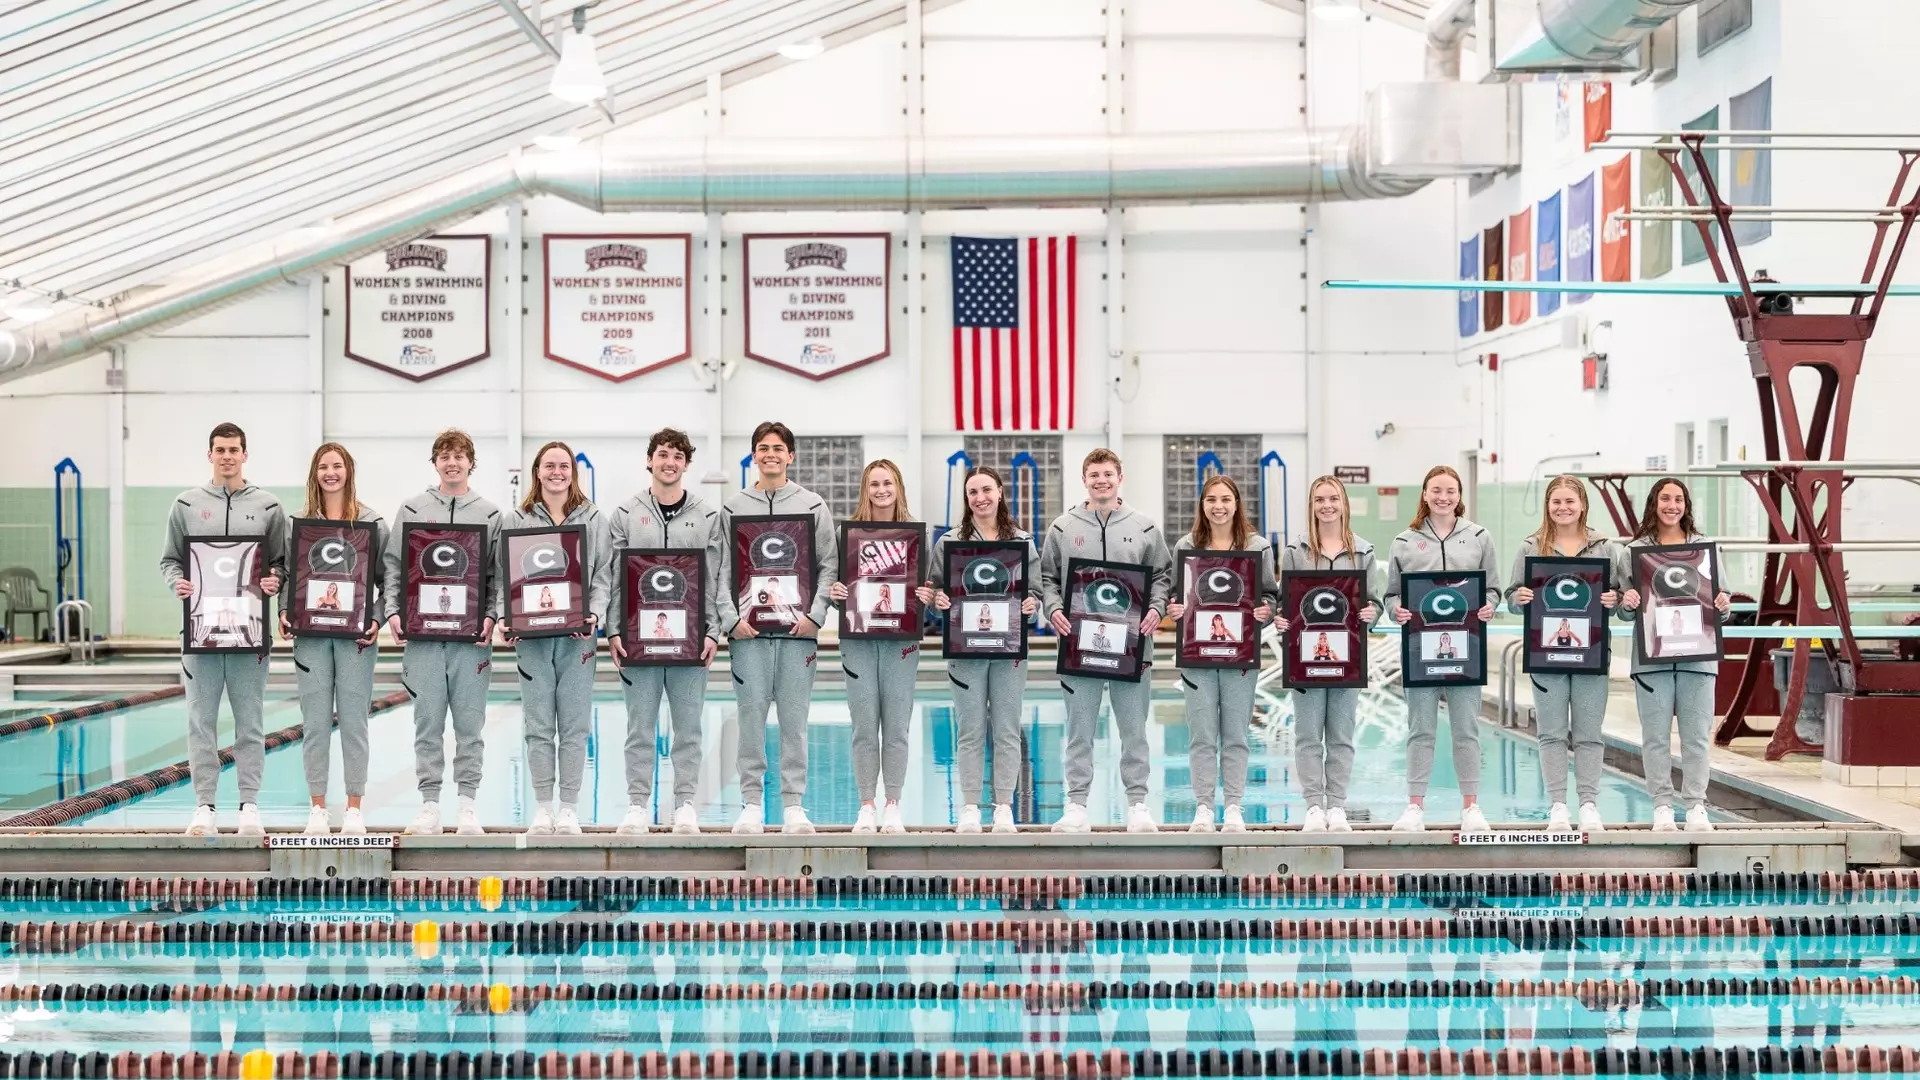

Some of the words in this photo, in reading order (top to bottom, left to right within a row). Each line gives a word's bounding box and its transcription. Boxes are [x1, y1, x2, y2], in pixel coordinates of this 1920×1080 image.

[354, 277, 411, 288] WOMEN'S
[416, 277, 483, 288] SWIMMING
[553, 277, 611, 288] WOMEN'S
[616, 277, 683, 288] SWIMMING
[753, 276, 810, 287] WOMEN'S
[815, 276, 883, 287] SWIMMING
[389, 294, 398, 305] &
[402, 294, 446, 305] DIVING
[589, 294, 598, 305] &
[602, 294, 646, 305] DIVING
[789, 293, 798, 304] &
[802, 293, 845, 304] DIVING
[381, 311, 454, 322] CHAMPIONS
[581, 311, 654, 322] CHAMPIONS
[781, 310, 854, 321] CHAMPIONS
[403, 328, 433, 339] 2008
[603, 328, 633, 339] 2009
[805, 327, 831, 338] 2011
[510, 475, 519, 486] 4
[321, 542, 345, 565] C
[761, 537, 785, 560] C
[432, 545, 457, 567] C
[532, 548, 556, 569] C
[213, 556, 237, 579] C
[973, 563, 997, 586] C
[1663, 566, 1688, 589] C
[650, 571, 675, 592] C
[1208, 570, 1231, 593] C
[1096, 583, 1120, 607] C
[1554, 578, 1579, 601] C
[1312, 592, 1337, 615] C
[1431, 594, 1456, 616] C
[271, 837, 278, 846] 6
[280, 837, 307, 846] FEET
[310, 837, 317, 846] 6
[319, 837, 360, 846] INCHES
[363, 837, 392, 846] DEEP
[1461, 834, 1468, 843] 6
[1469, 834, 1497, 843] FEET
[1499, 834, 1506, 843] 6
[1508, 834, 1550, 843] INCHES
[1552, 834, 1581, 843] DEEP
